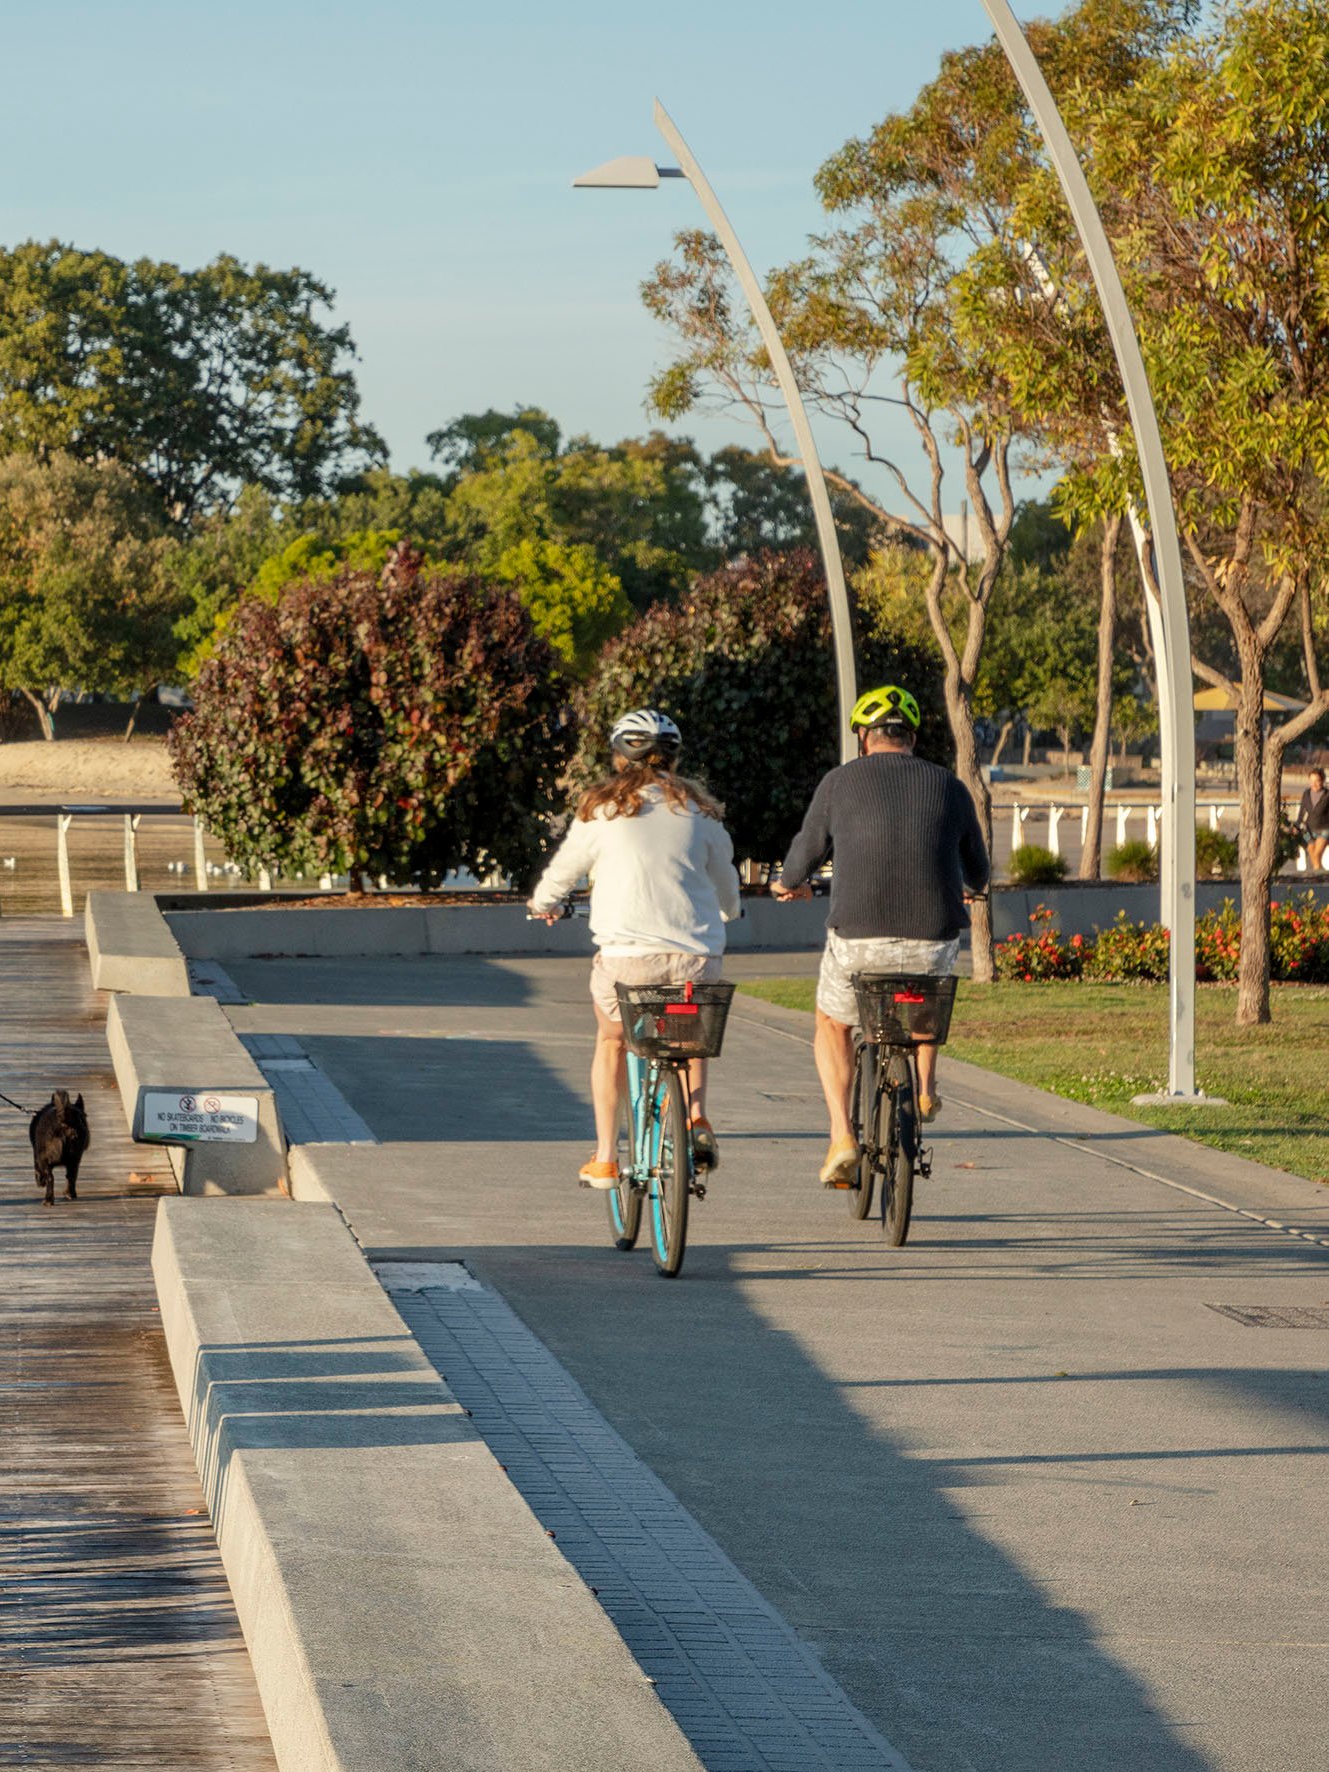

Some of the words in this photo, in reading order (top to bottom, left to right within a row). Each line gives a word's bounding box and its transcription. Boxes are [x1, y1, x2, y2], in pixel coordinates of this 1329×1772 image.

[157, 1112, 166, 1121] NO
[167, 1112, 204, 1123] SKATEBOARDS
[210, 1115, 219, 1123] NO
[169, 1123, 178, 1131] ON
[179, 1123, 198, 1132] TIMBER
